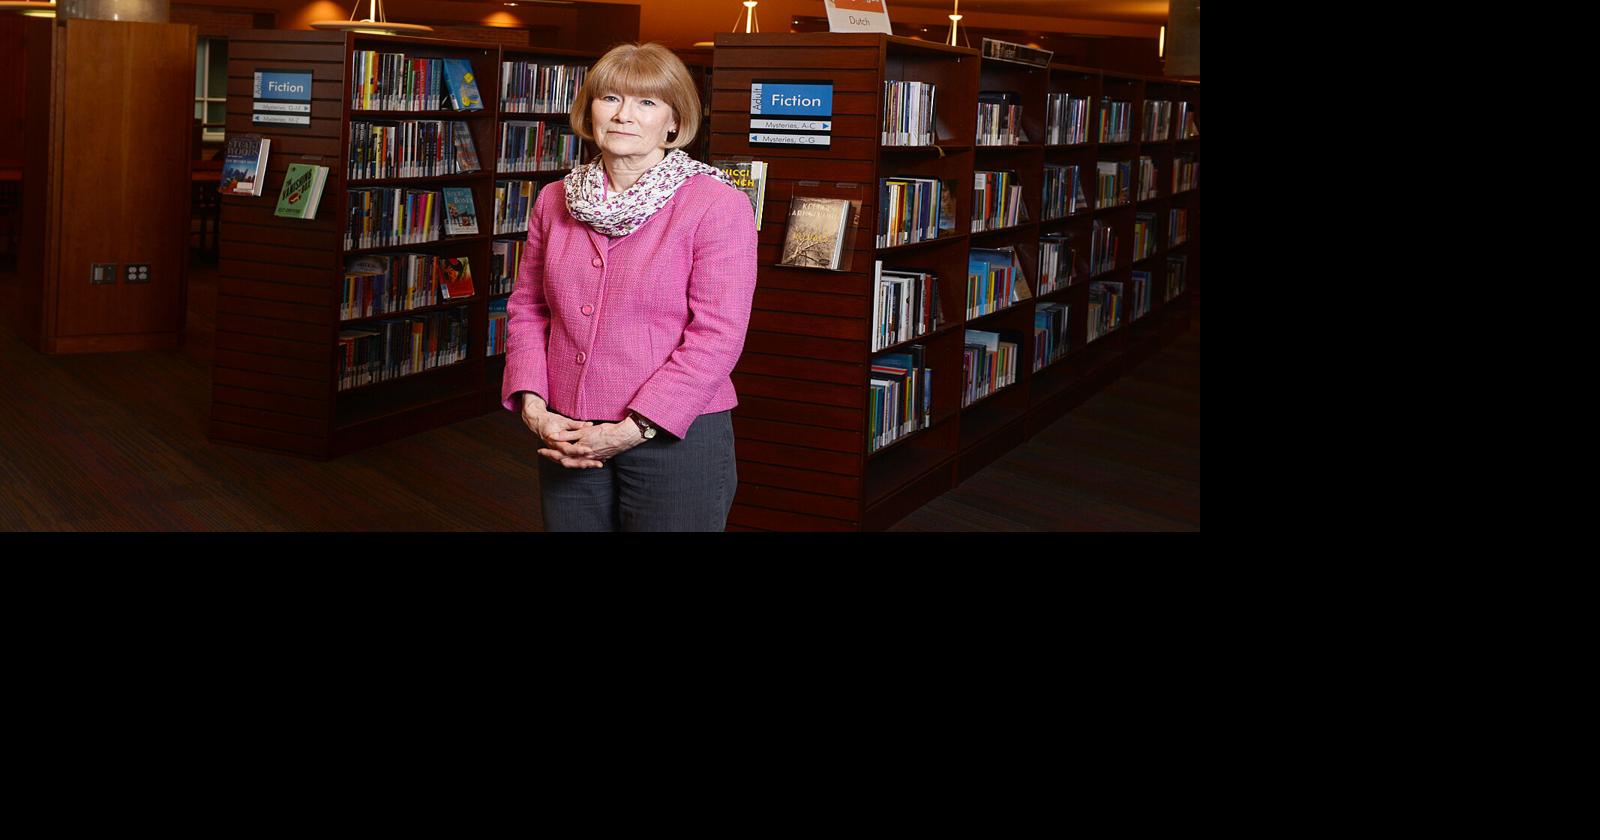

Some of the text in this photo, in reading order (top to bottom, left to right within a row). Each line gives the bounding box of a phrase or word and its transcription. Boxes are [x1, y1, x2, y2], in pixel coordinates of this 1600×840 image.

[849, 16, 871, 27] Dutch
[268, 81, 304, 93] Fiction
[752, 88, 762, 110] Adult
[772, 94, 821, 107] Fiction
[765, 121, 816, 130] Mysteries, A-C
[762, 136, 816, 144] Mysteries, C-G
[721, 168, 750, 177] NICCI
[733, 179, 755, 187] NCH
